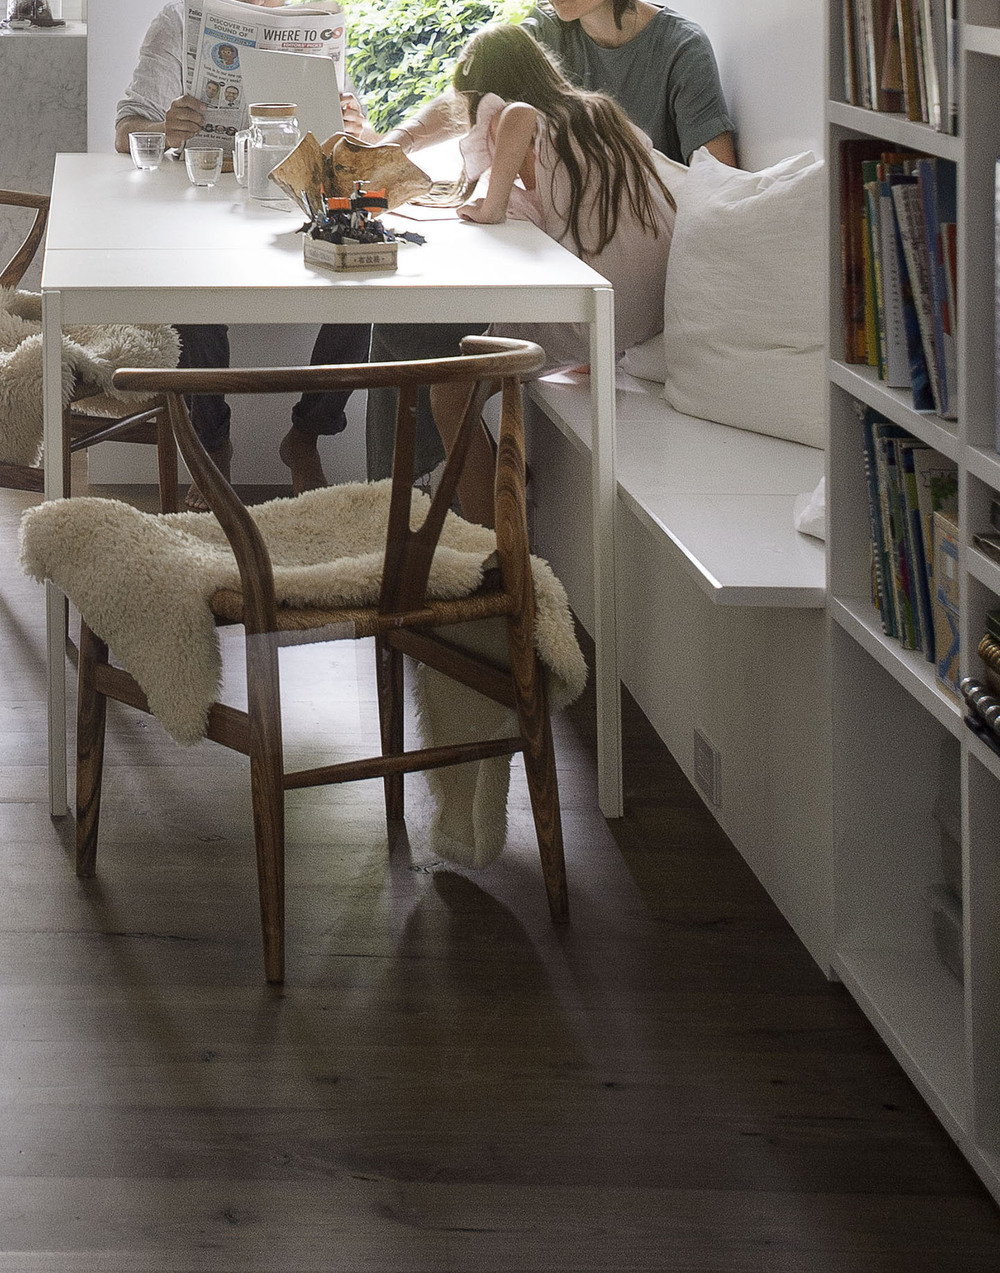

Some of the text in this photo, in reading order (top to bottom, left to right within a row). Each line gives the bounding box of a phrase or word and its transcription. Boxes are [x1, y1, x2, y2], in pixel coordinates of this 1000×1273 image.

[209, 16, 241, 30] DISCOVER
[242, 26, 254, 34] THE
[214, 23, 237, 35] SOUND
[263, 28, 300, 42] WHERE
[304, 29, 317, 42] TO
[320, 27, 343, 41] GO
